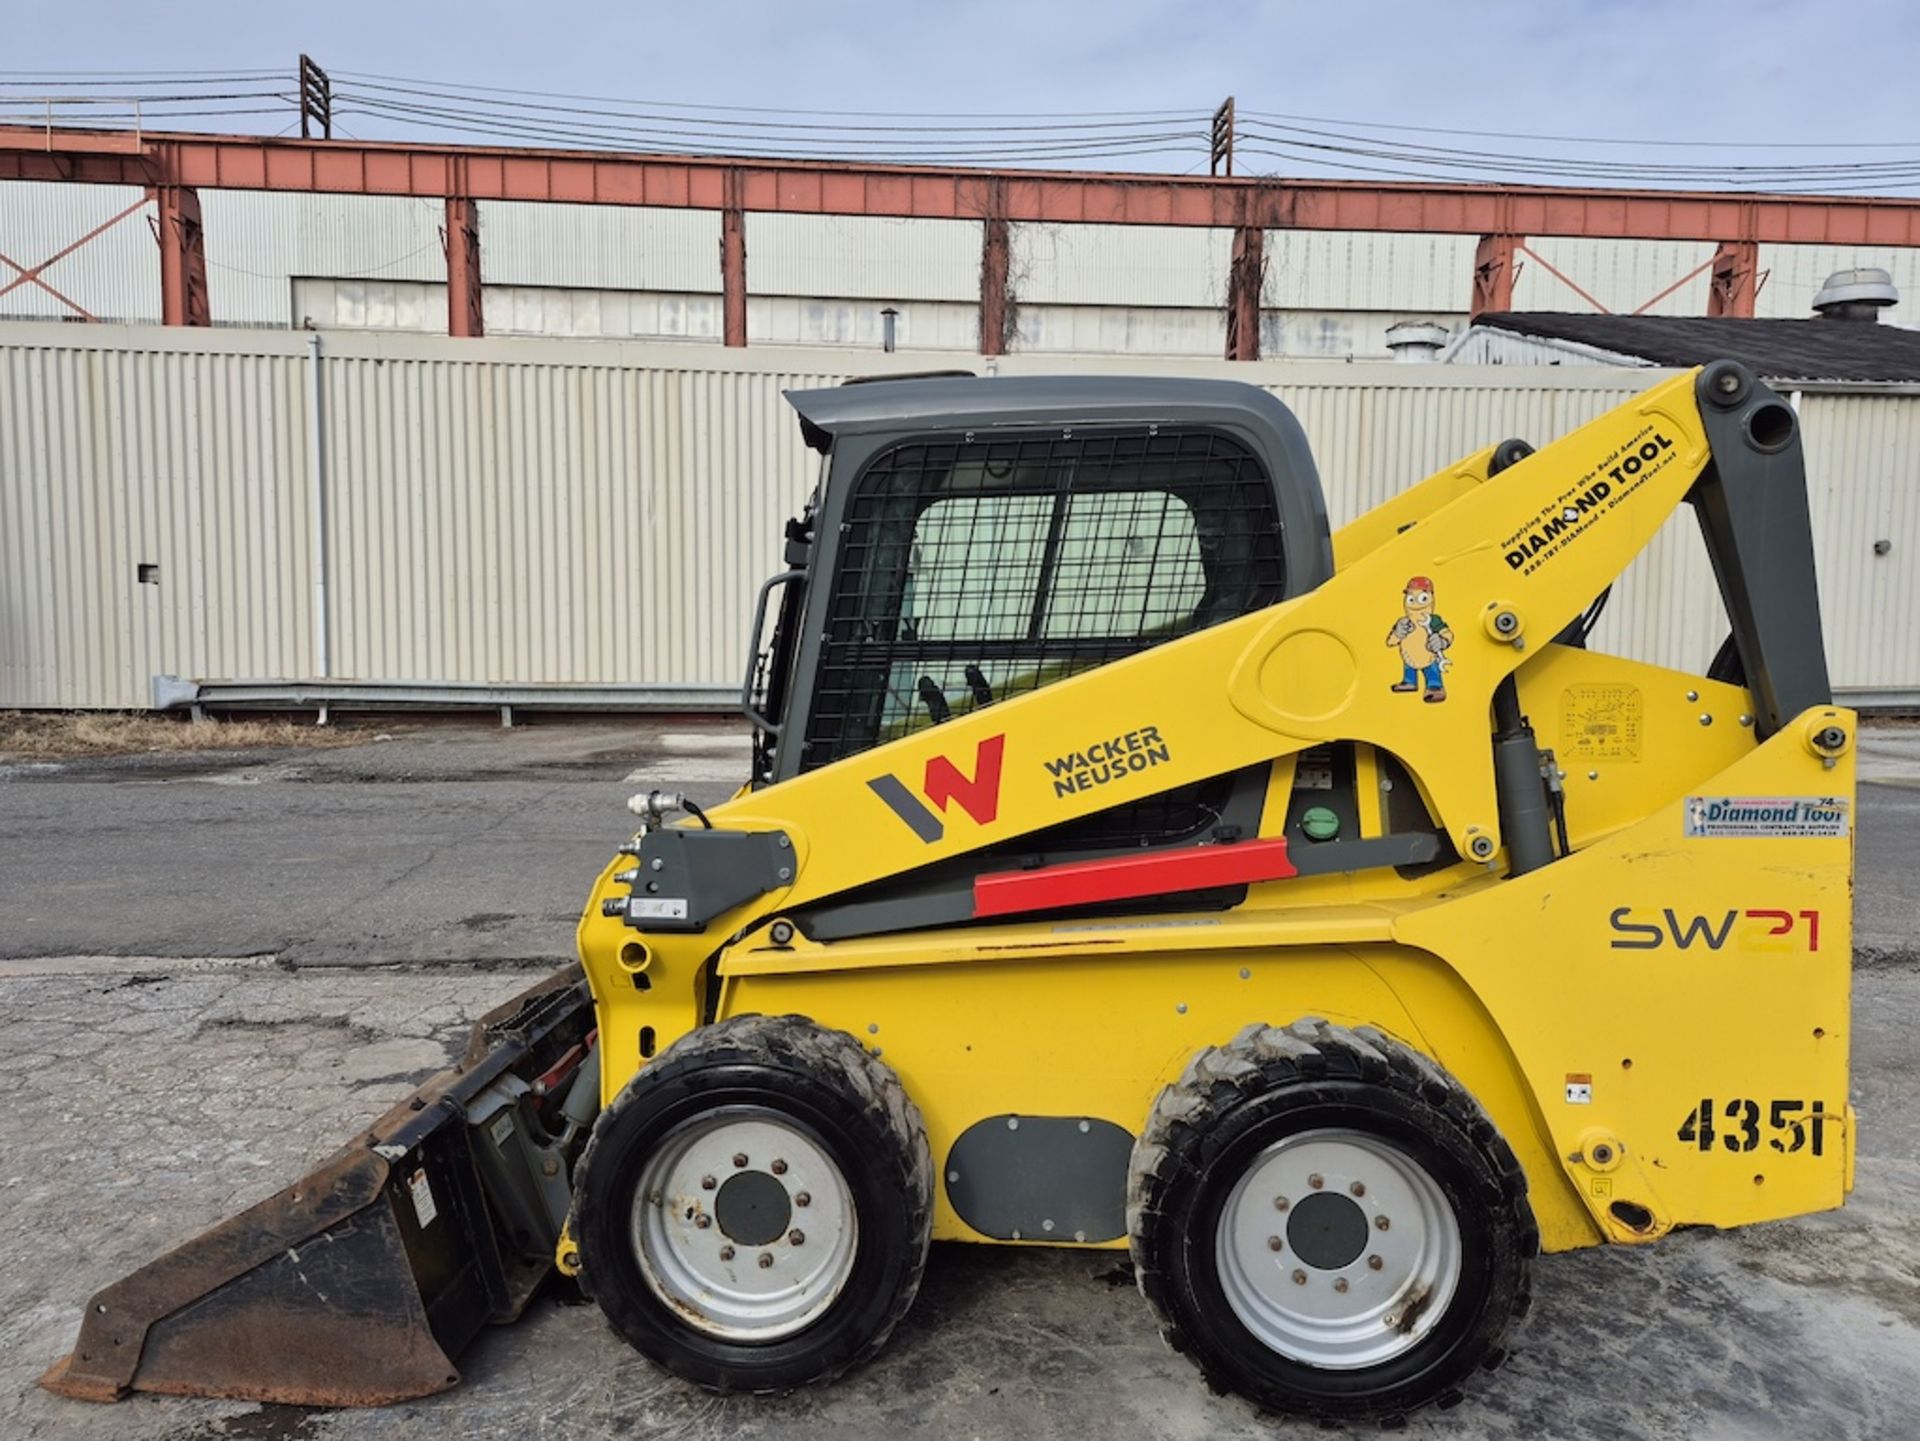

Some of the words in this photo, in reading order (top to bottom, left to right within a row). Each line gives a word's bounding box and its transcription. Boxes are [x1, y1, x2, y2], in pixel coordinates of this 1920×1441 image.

[1608, 433, 1673, 485] TOOL
[1501, 517, 1541, 549] Supplying
[1541, 504, 1556, 516] The
[1577, 471, 1596, 488] Who
[1597, 450, 1619, 471] Build
[1621, 424, 1654, 453] America
[1044, 726, 1163, 777] WACKER
[1053, 744, 1170, 799] NEUSON
[1707, 799, 1800, 822] Diamond
[1609, 907, 1819, 952] SW21
